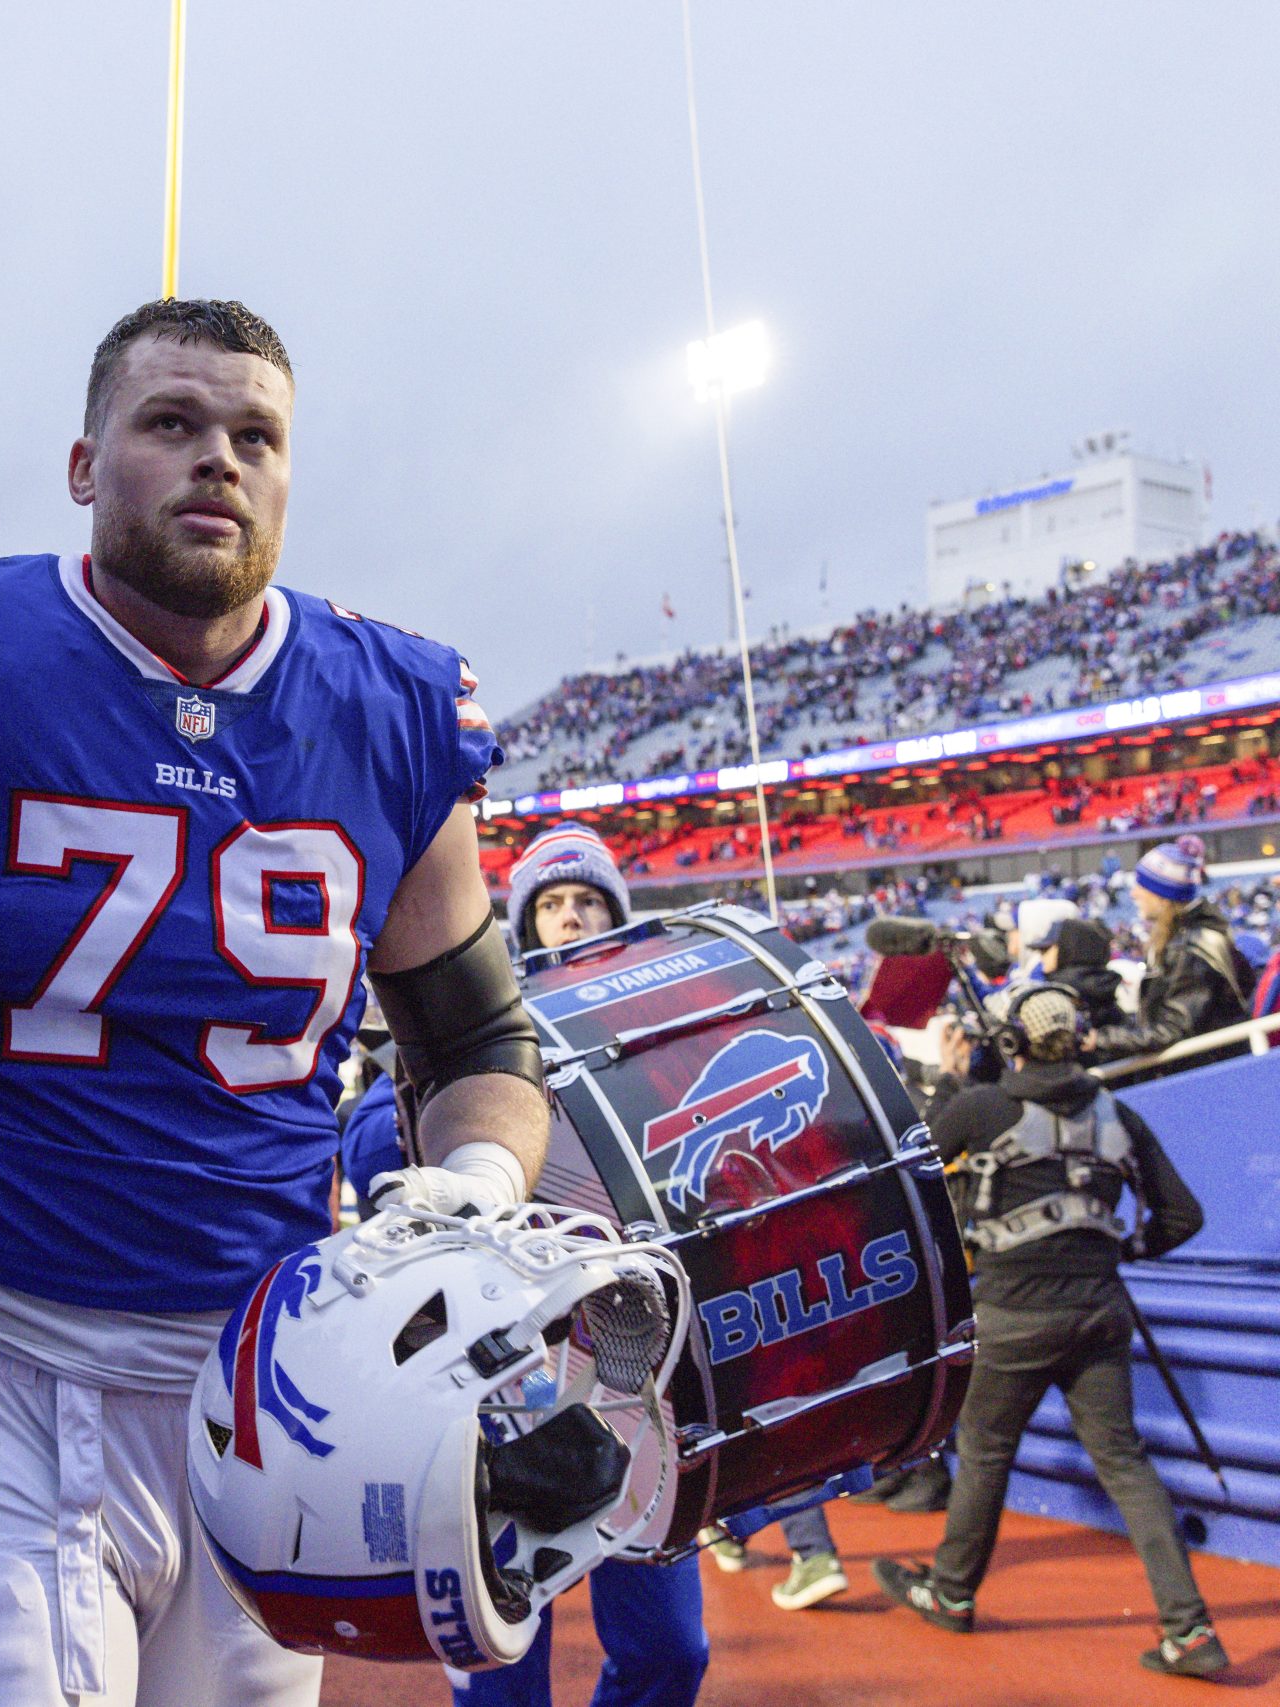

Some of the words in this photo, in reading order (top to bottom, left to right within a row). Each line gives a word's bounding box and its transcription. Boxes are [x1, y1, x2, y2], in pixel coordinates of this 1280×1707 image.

[182, 714, 207, 733] NFL
[155, 762, 236, 799] BILLS
[3, 790, 365, 1093] 79
[604, 953, 709, 993] YAMAHA
[698, 1229, 919, 1366] BILLS
